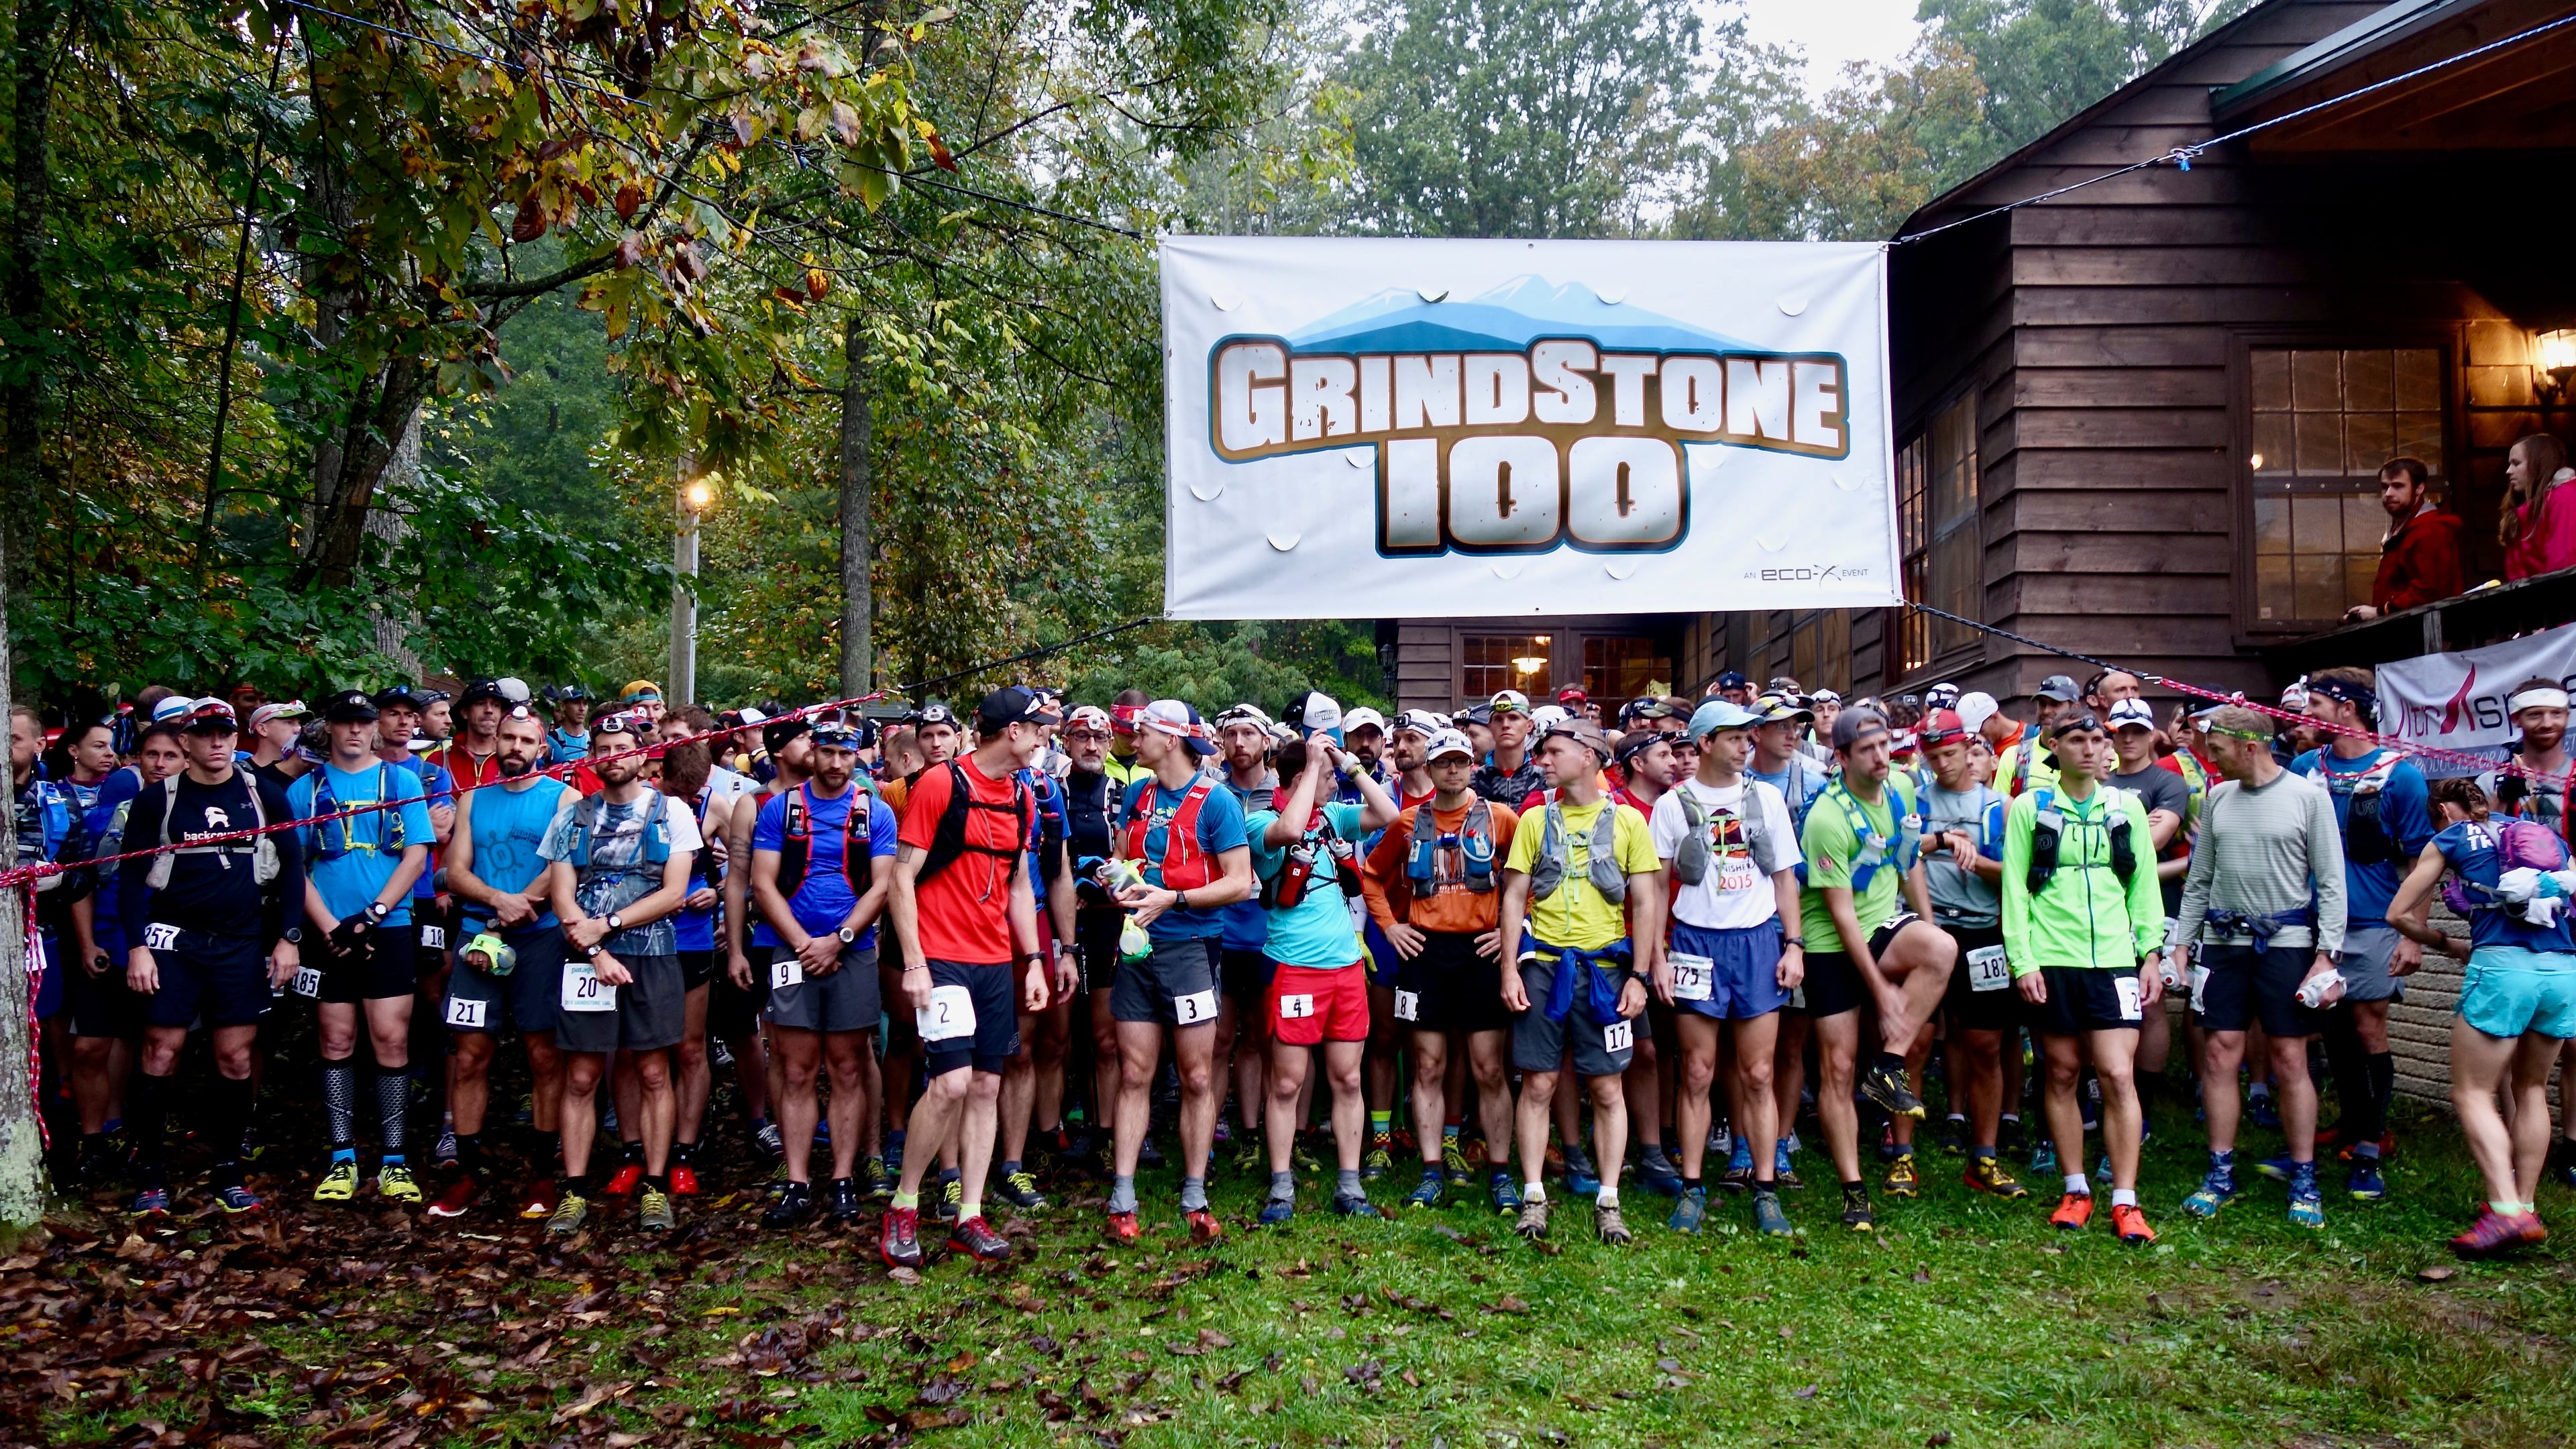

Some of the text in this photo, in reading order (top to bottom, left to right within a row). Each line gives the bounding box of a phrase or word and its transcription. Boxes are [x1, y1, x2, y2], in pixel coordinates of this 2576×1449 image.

[1215, 337, 1843, 455] GRINDSTONE
[1384, 434, 1682, 548] 100
[1842, 569, 1868, 577] EVENT
[1720, 874, 1752, 890] 2015
[781, 965, 788, 985] 9
[1674, 965, 1699, 985] 175
[1981, 957, 2006, 979] 182
[294, 970, 318, 994] 185
[578, 977, 598, 998] 20
[456, 1002, 475, 1023] 21
[938, 1002, 950, 1024] 2
[1185, 999, 1197, 1018] 3
[1293, 996, 1301, 1017] 4
[1401, 996, 1407, 1016] 8
[1610, 1026, 1625, 1049] 17
